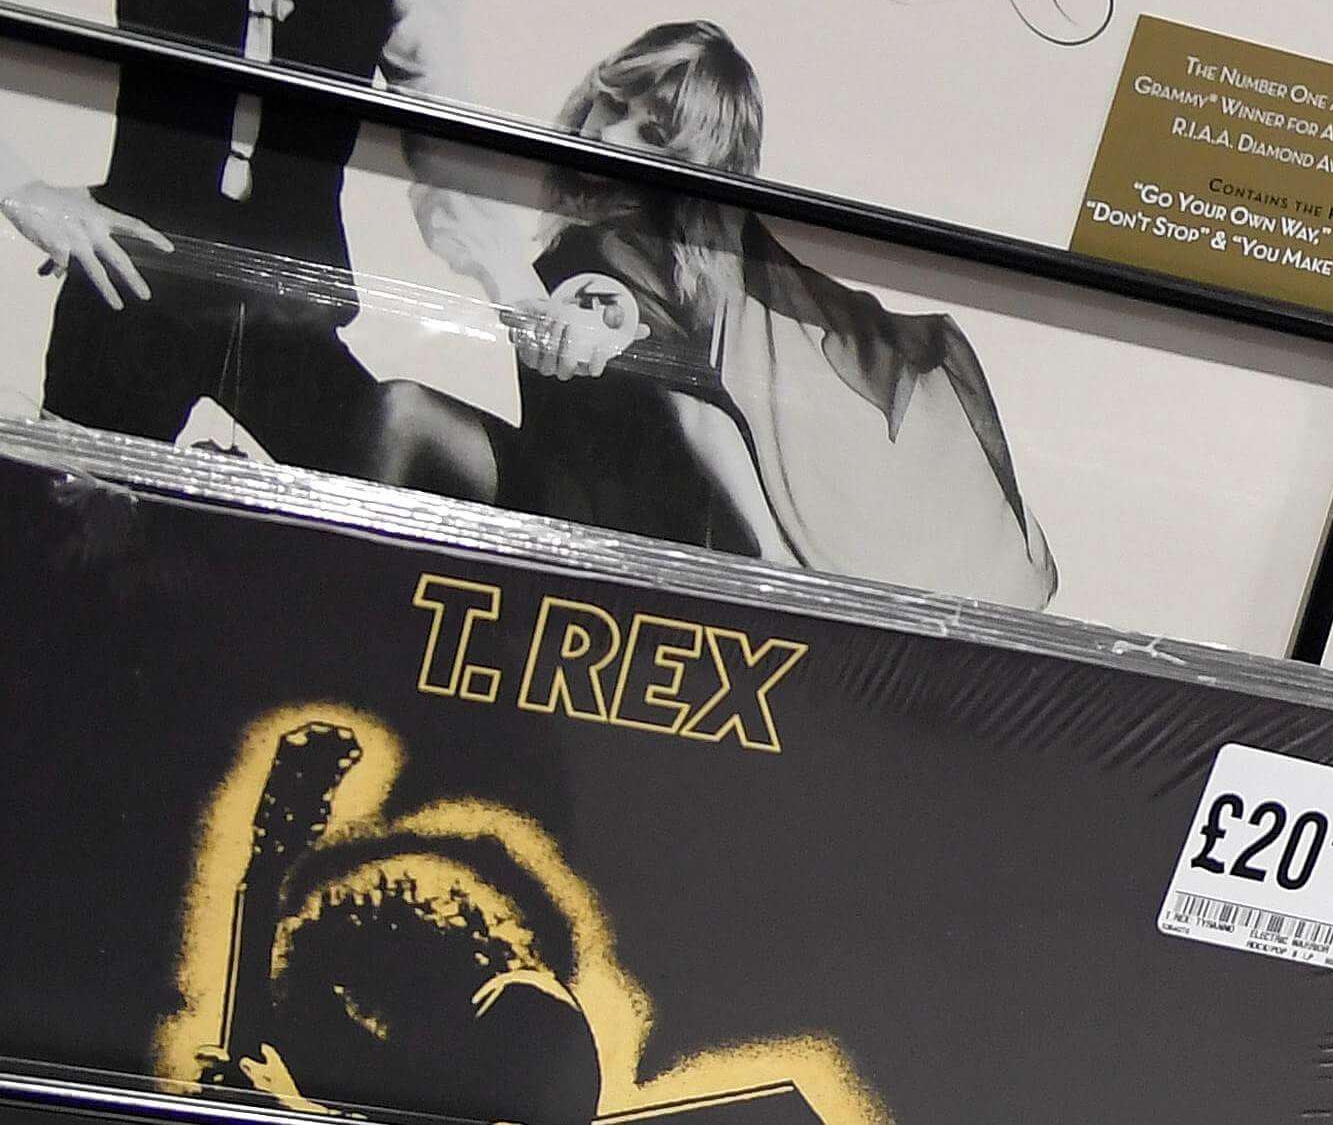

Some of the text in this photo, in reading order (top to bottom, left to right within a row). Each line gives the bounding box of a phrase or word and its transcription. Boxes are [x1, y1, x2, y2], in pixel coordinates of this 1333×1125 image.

[1186, 55, 1218, 81] THE
[1220, 66, 1288, 99] NUMBER
[1290, 85, 1328, 109] ONE
[1220, 96, 1285, 128] WINNER
[1287, 118, 1319, 137] FOR
[1171, 116, 1233, 149] R.I.A.A.
[1237, 133, 1314, 168] DIAMOND
[1178, 192, 1228, 222] YOUR
[1230, 206, 1277, 232] OWN
[1209, 178, 1288, 209] CONTAINS
[1294, 201, 1323, 218] THE
[1210, 230, 1228, 251] &
[1281, 247, 1333, 276] MAKE
[413, 573, 809, 754] T. REX
